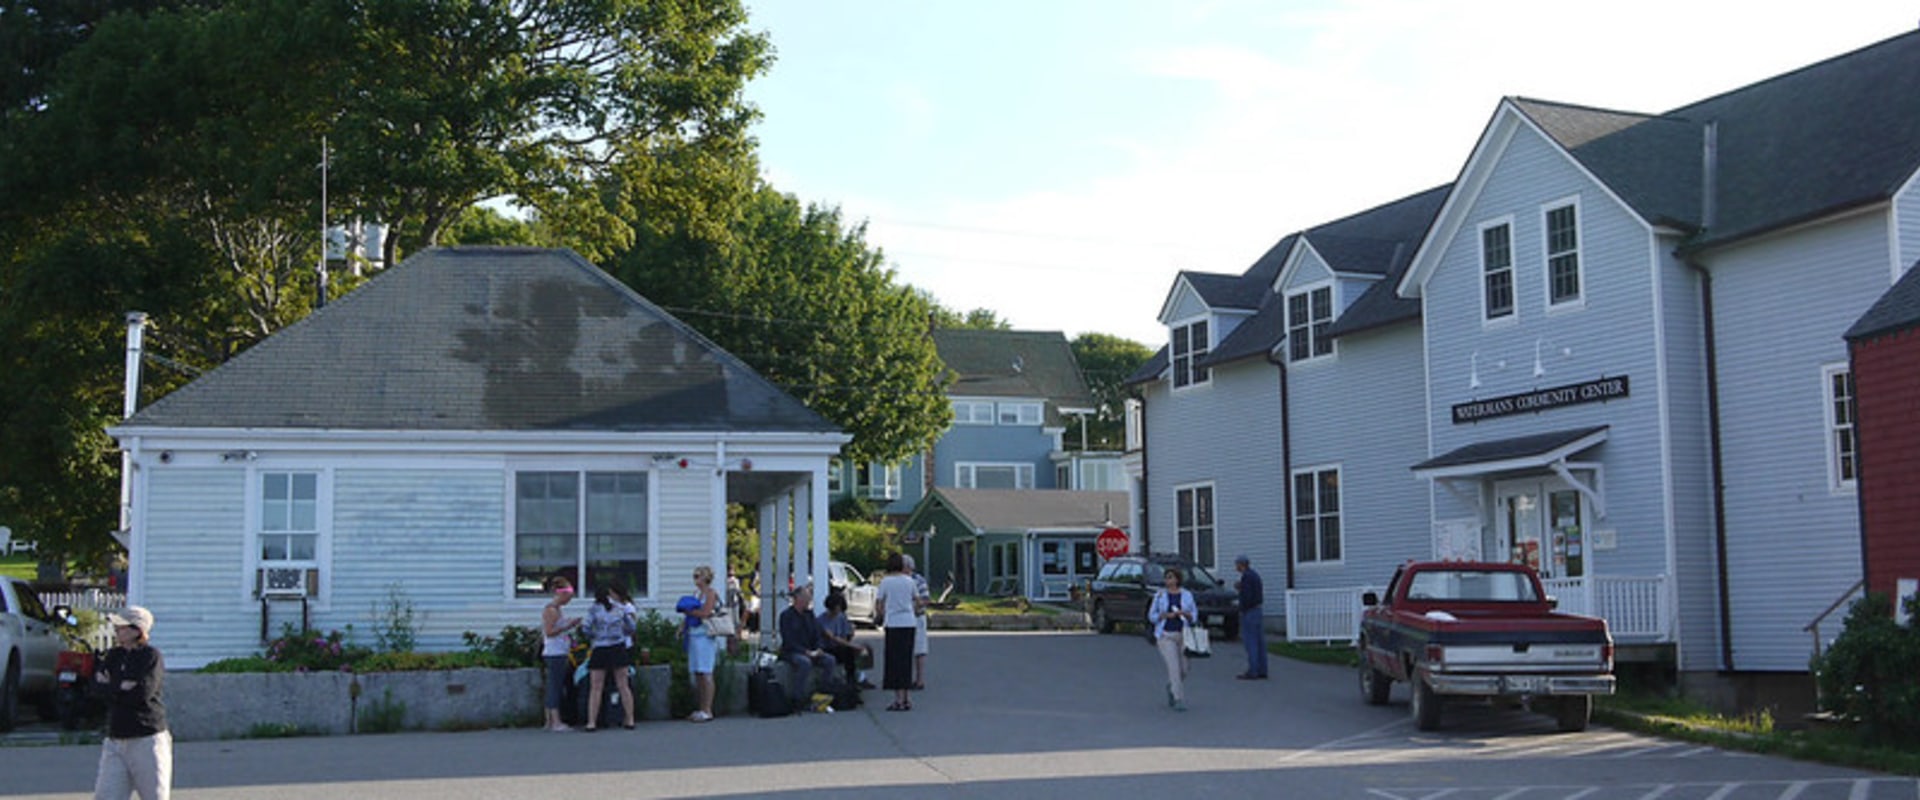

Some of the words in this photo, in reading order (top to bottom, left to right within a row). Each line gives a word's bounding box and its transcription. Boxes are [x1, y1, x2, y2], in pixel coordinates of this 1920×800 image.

[1516, 390, 1577, 409] COMMUNITY
[1580, 381, 1623, 397] CENTER
[1098, 538, 1127, 551] STOP
